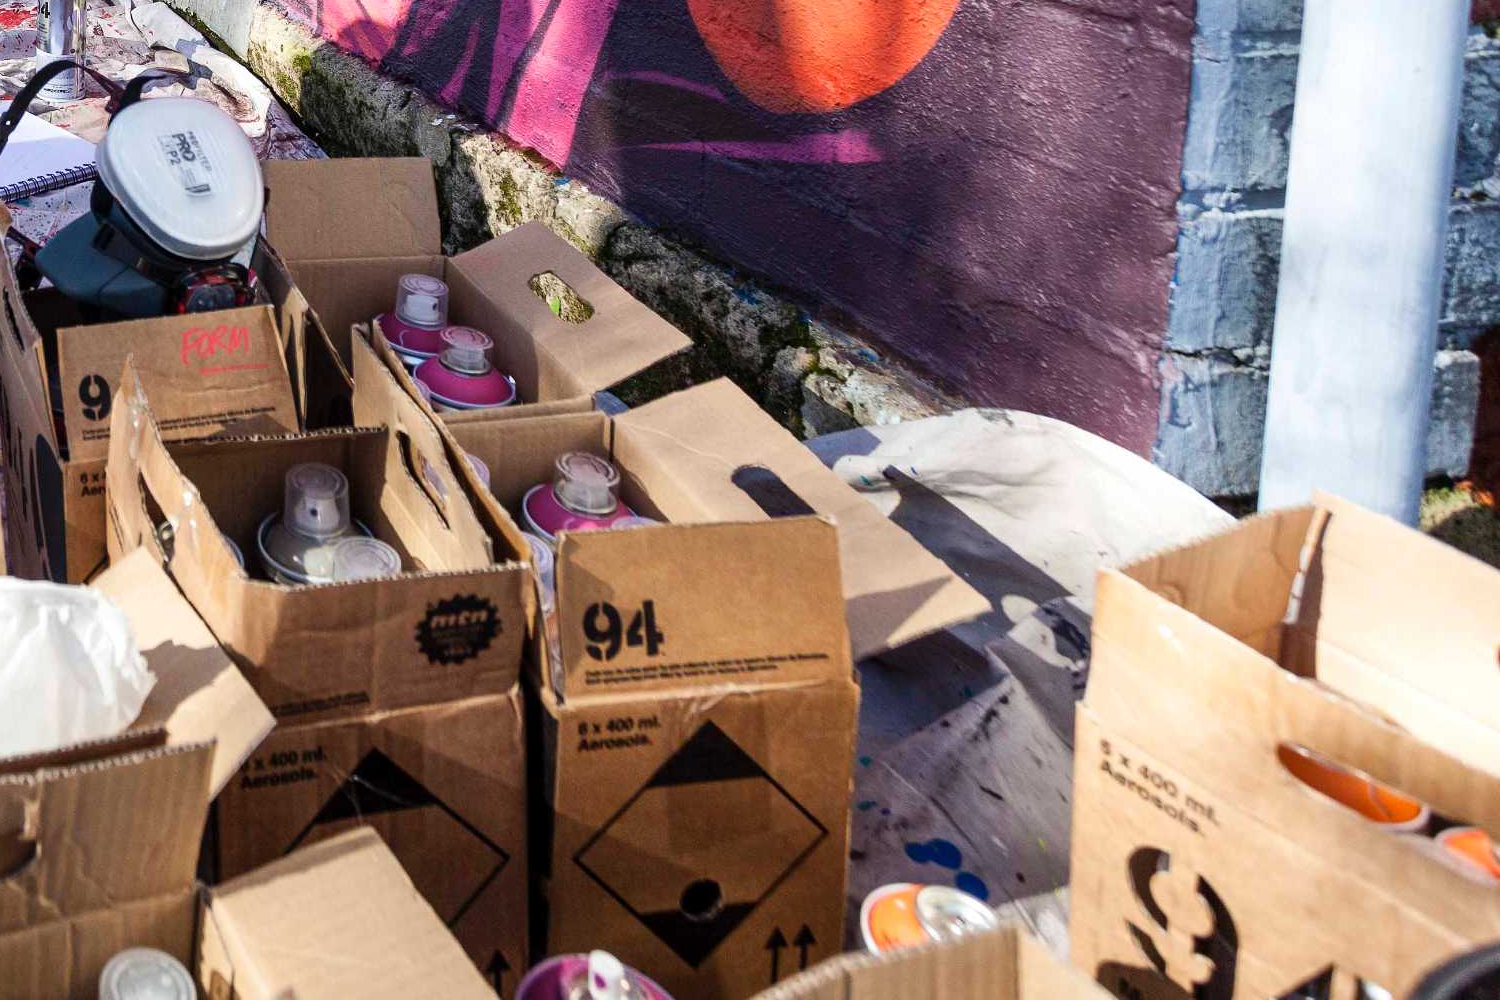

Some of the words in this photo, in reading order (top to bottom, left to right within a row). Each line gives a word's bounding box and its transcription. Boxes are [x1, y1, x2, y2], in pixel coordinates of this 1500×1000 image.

[181, 324, 252, 368] FORM
[583, 600, 664, 662] 94
[593, 722, 601, 734] x
[606, 717, 634, 733] 400
[270, 750, 298, 767] 400
[1119, 753, 1131, 769] x
[1139, 764, 1179, 799] 400
